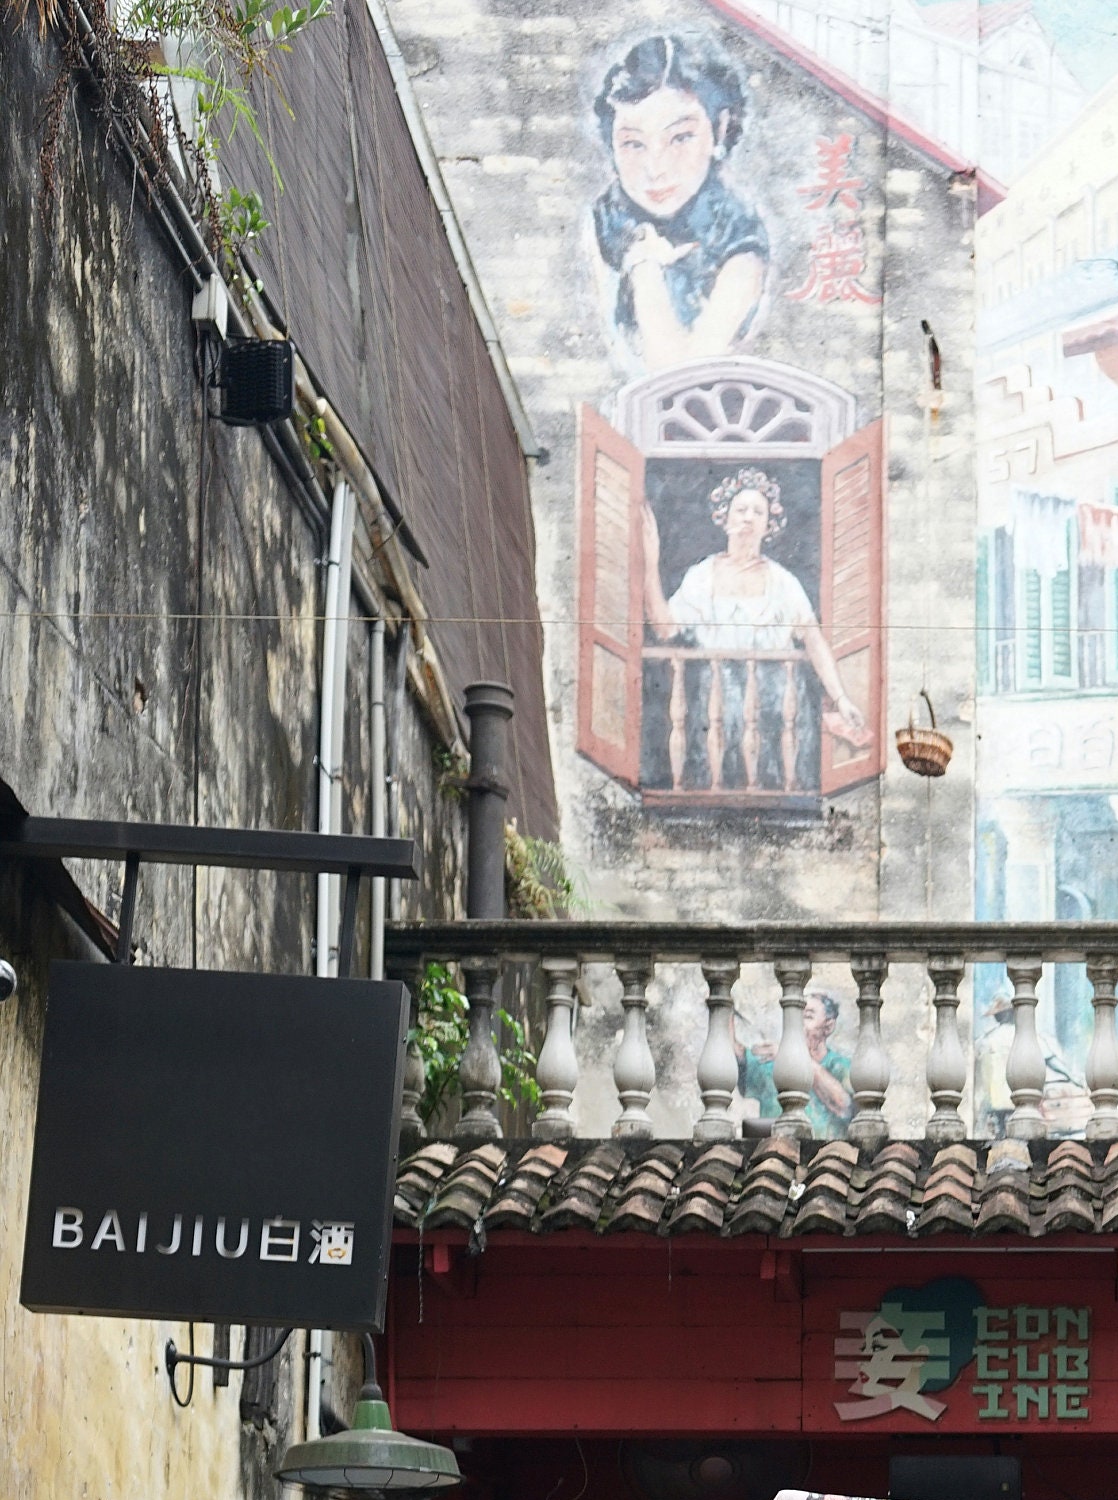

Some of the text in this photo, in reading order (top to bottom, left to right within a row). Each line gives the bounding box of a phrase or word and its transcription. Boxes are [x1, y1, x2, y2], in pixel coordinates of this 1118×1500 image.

[785, 133, 881, 303] 美麗
[973, 1306, 1088, 1341] CON
[973, 1345, 1088, 1379] CUB
[973, 1384, 1088, 1419] INE
